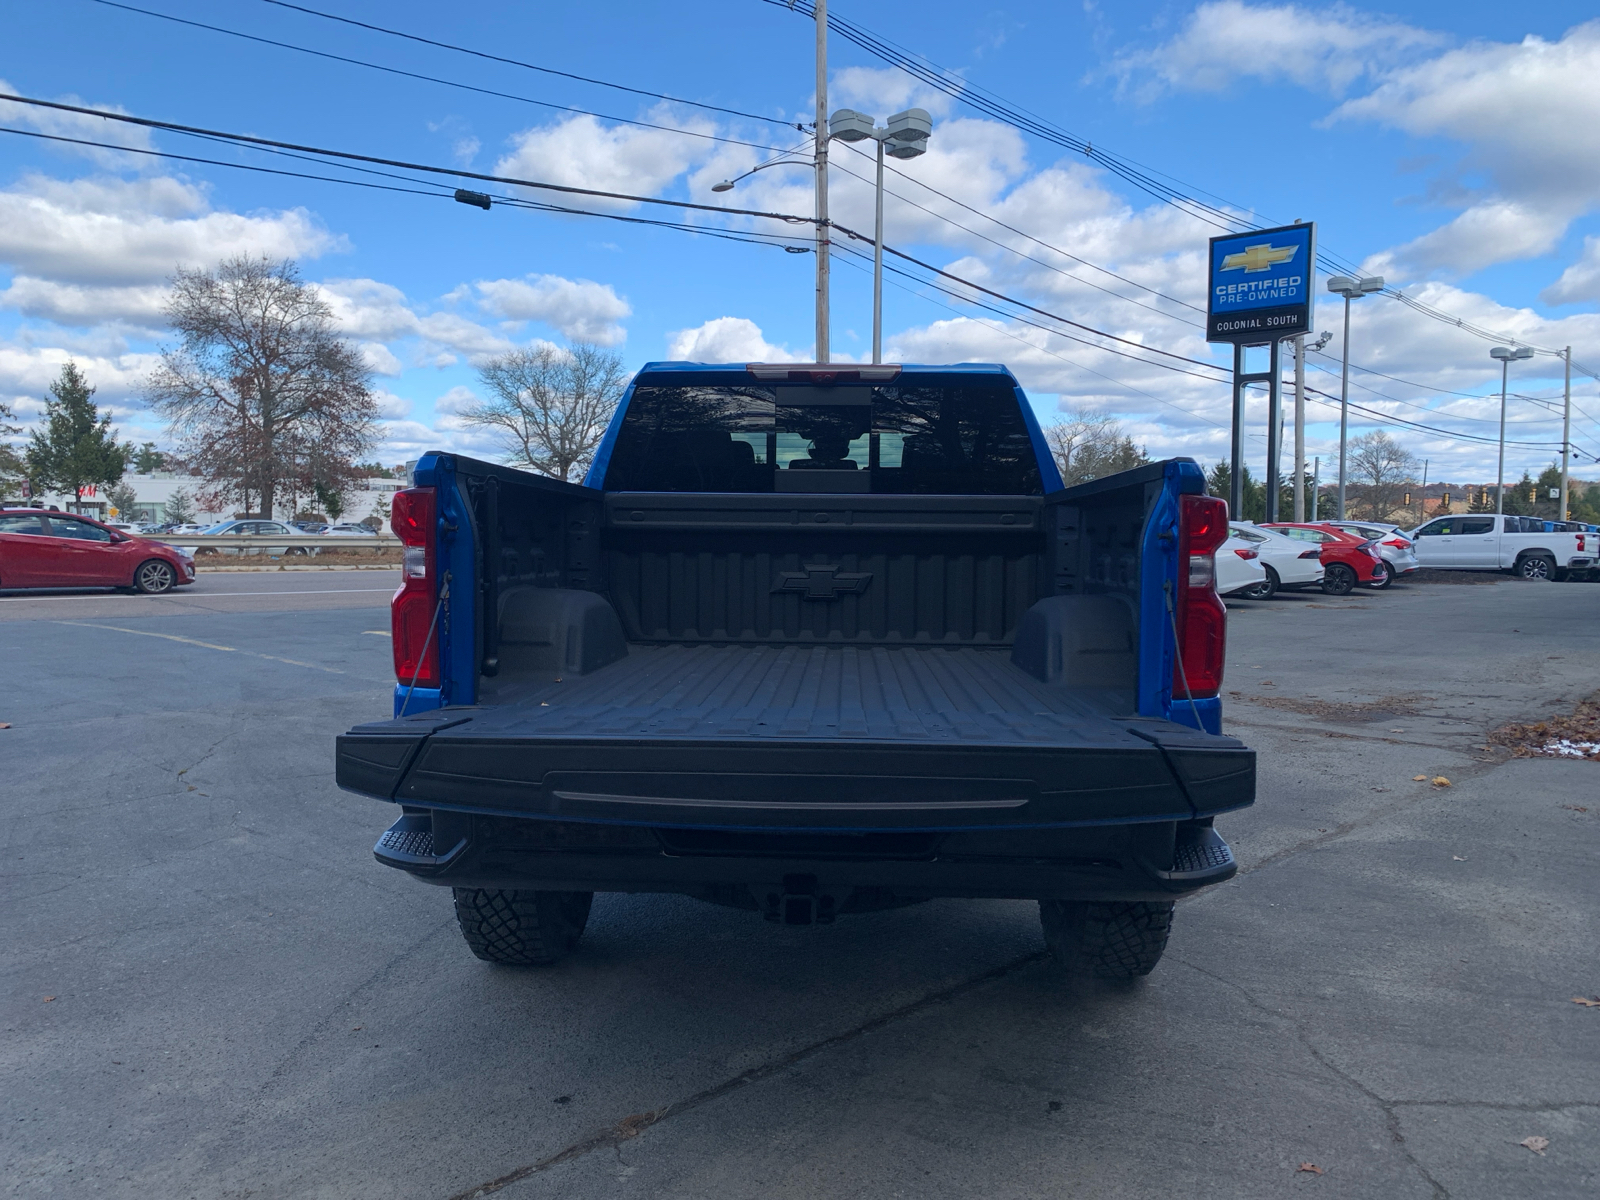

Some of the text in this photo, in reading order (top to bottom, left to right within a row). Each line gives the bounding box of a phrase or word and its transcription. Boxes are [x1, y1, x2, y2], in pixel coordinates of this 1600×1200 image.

[1216, 276, 1301, 295] CERTIFIED
[1220, 287, 1297, 304] PRE-OWNED
[1217, 315, 1298, 331] COLONIAL SOUTH
